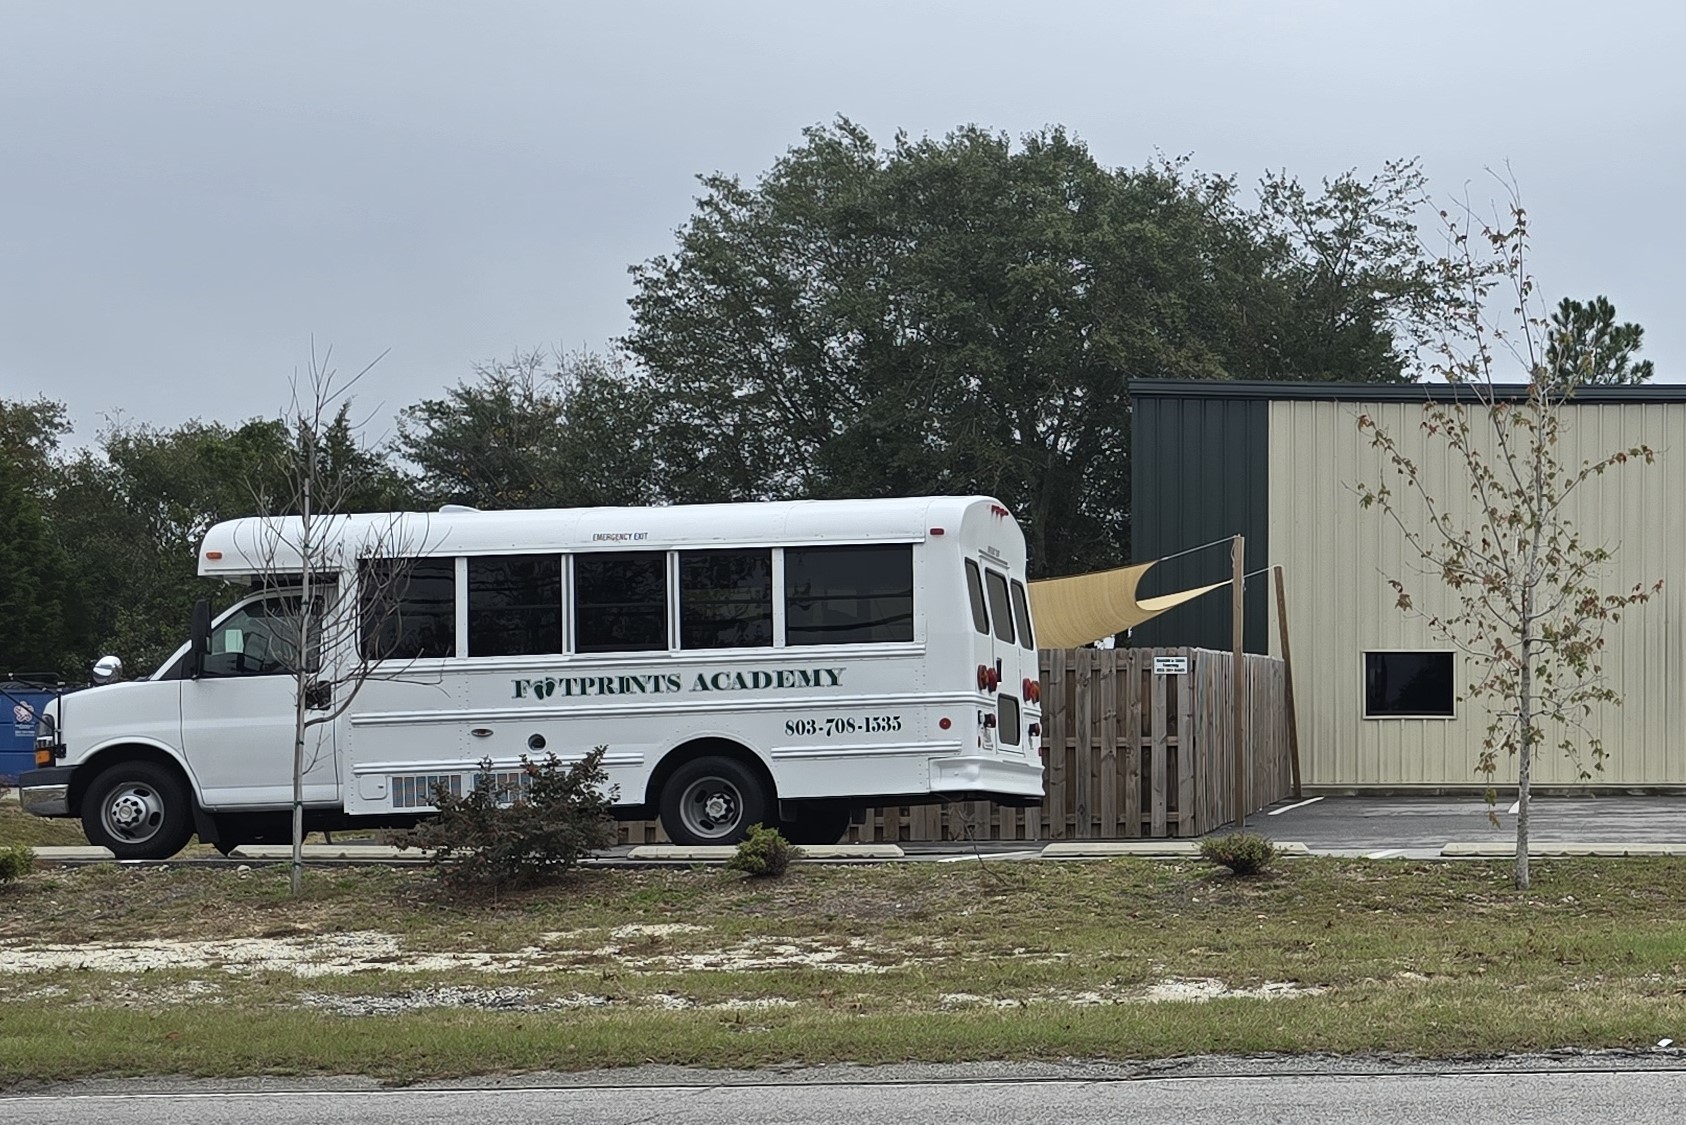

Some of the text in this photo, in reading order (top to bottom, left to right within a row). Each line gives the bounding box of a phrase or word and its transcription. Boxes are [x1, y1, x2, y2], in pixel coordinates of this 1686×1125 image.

[511, 667, 846, 700] FTPRINTS ACADEMY
[785, 715, 901, 737] 803-708-1535
